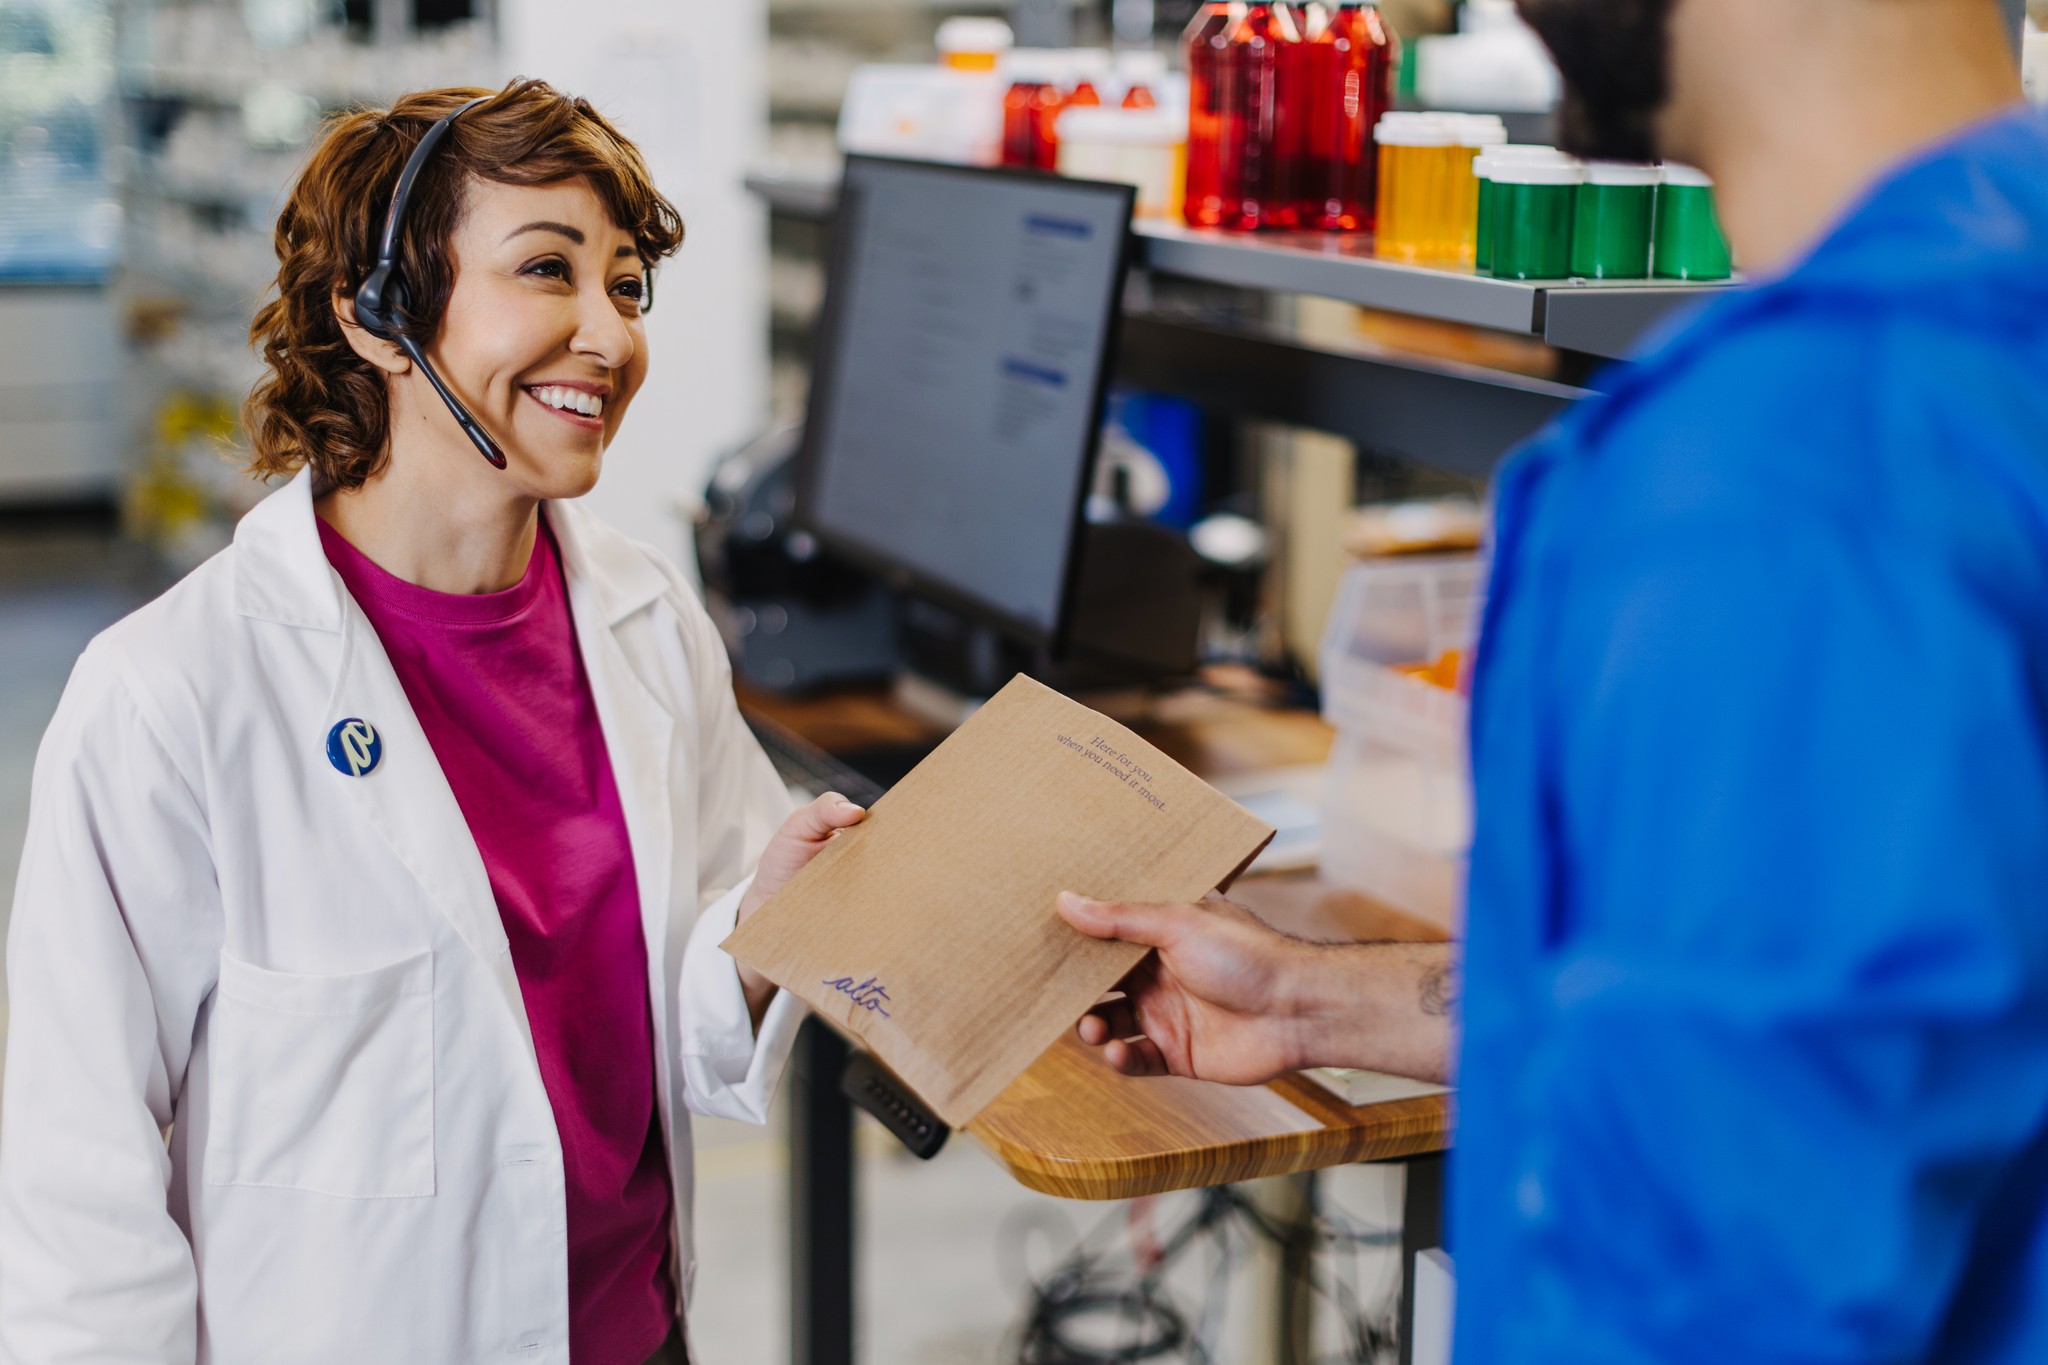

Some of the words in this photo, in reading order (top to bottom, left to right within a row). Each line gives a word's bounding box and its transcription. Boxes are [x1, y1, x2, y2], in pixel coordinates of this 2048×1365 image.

[1056, 734, 1084, 752] when
[1081, 748, 1103, 764] you
[1102, 761, 1131, 782] need
[1128, 778, 1138, 789] it
[1137, 787, 1166, 812] most.
[1091, 736, 1117, 757] Here
[1116, 753, 1134, 767] for
[1132, 765, 1153, 783] you
[822, 977, 891, 1018] alto
